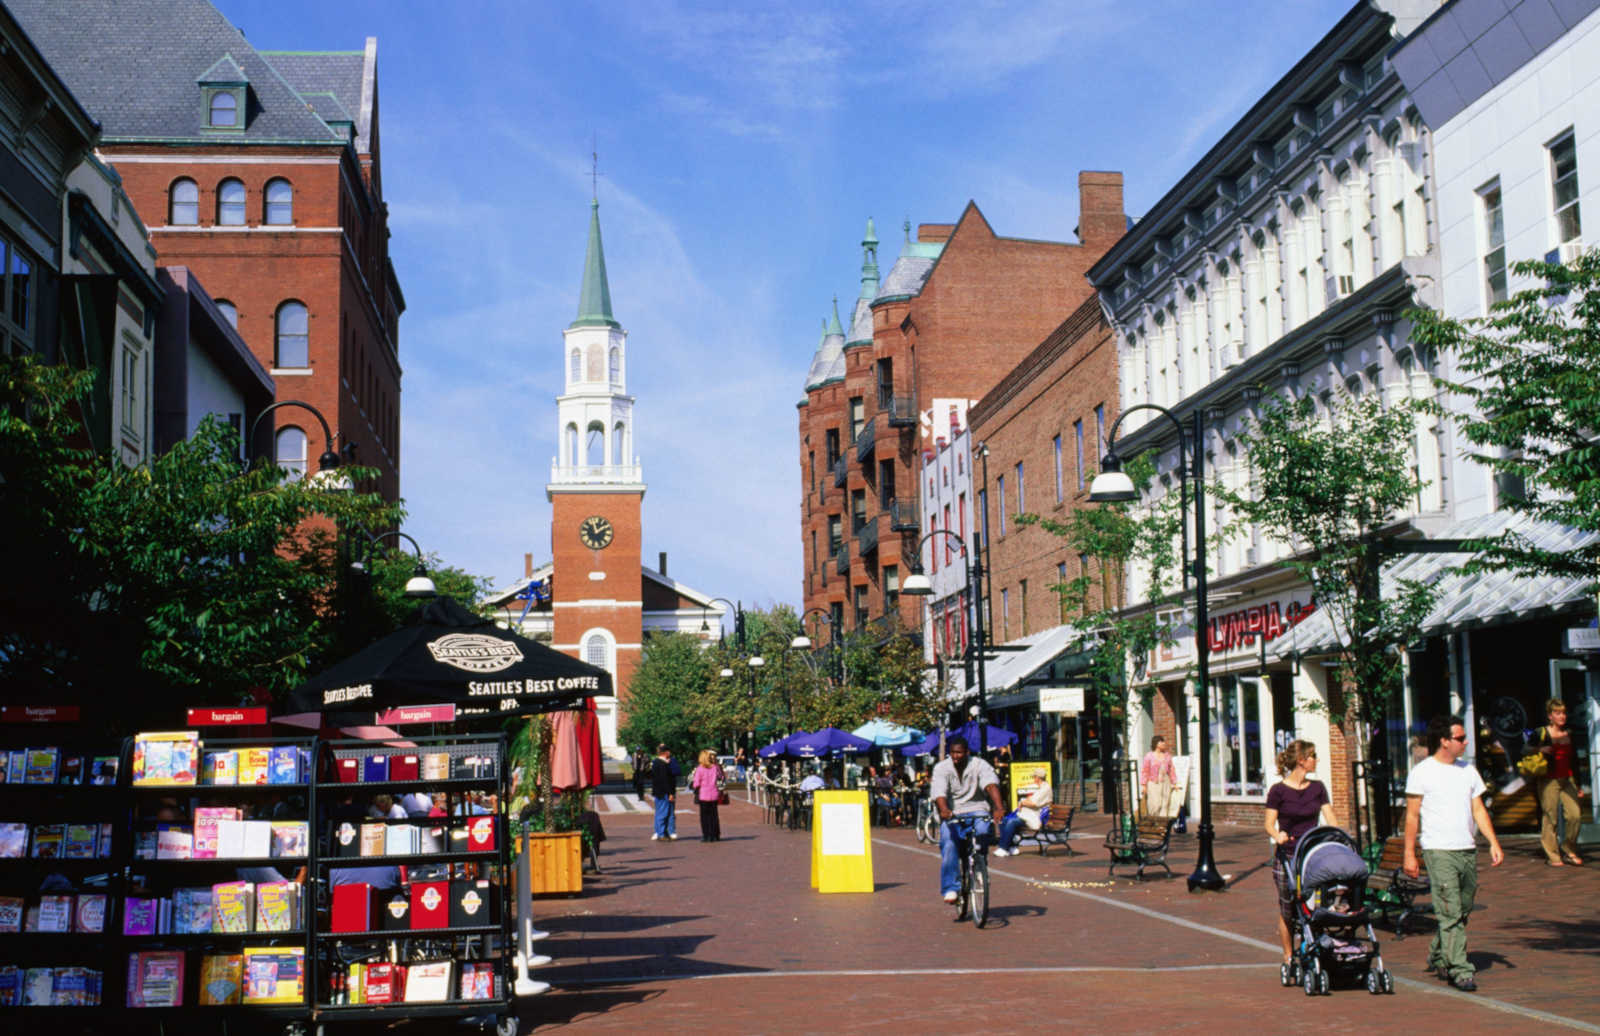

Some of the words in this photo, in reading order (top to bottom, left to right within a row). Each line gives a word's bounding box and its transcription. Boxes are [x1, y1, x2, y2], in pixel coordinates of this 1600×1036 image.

[1196, 601, 1286, 652] LYMPIA
[488, 645, 517, 656] BEST
[468, 681, 523, 696] SEATTLE'S
[525, 678, 555, 693] BEST
[557, 676, 599, 689] COFFEE
[211, 711, 244, 723] bargain
[400, 711, 432, 721] bargain
